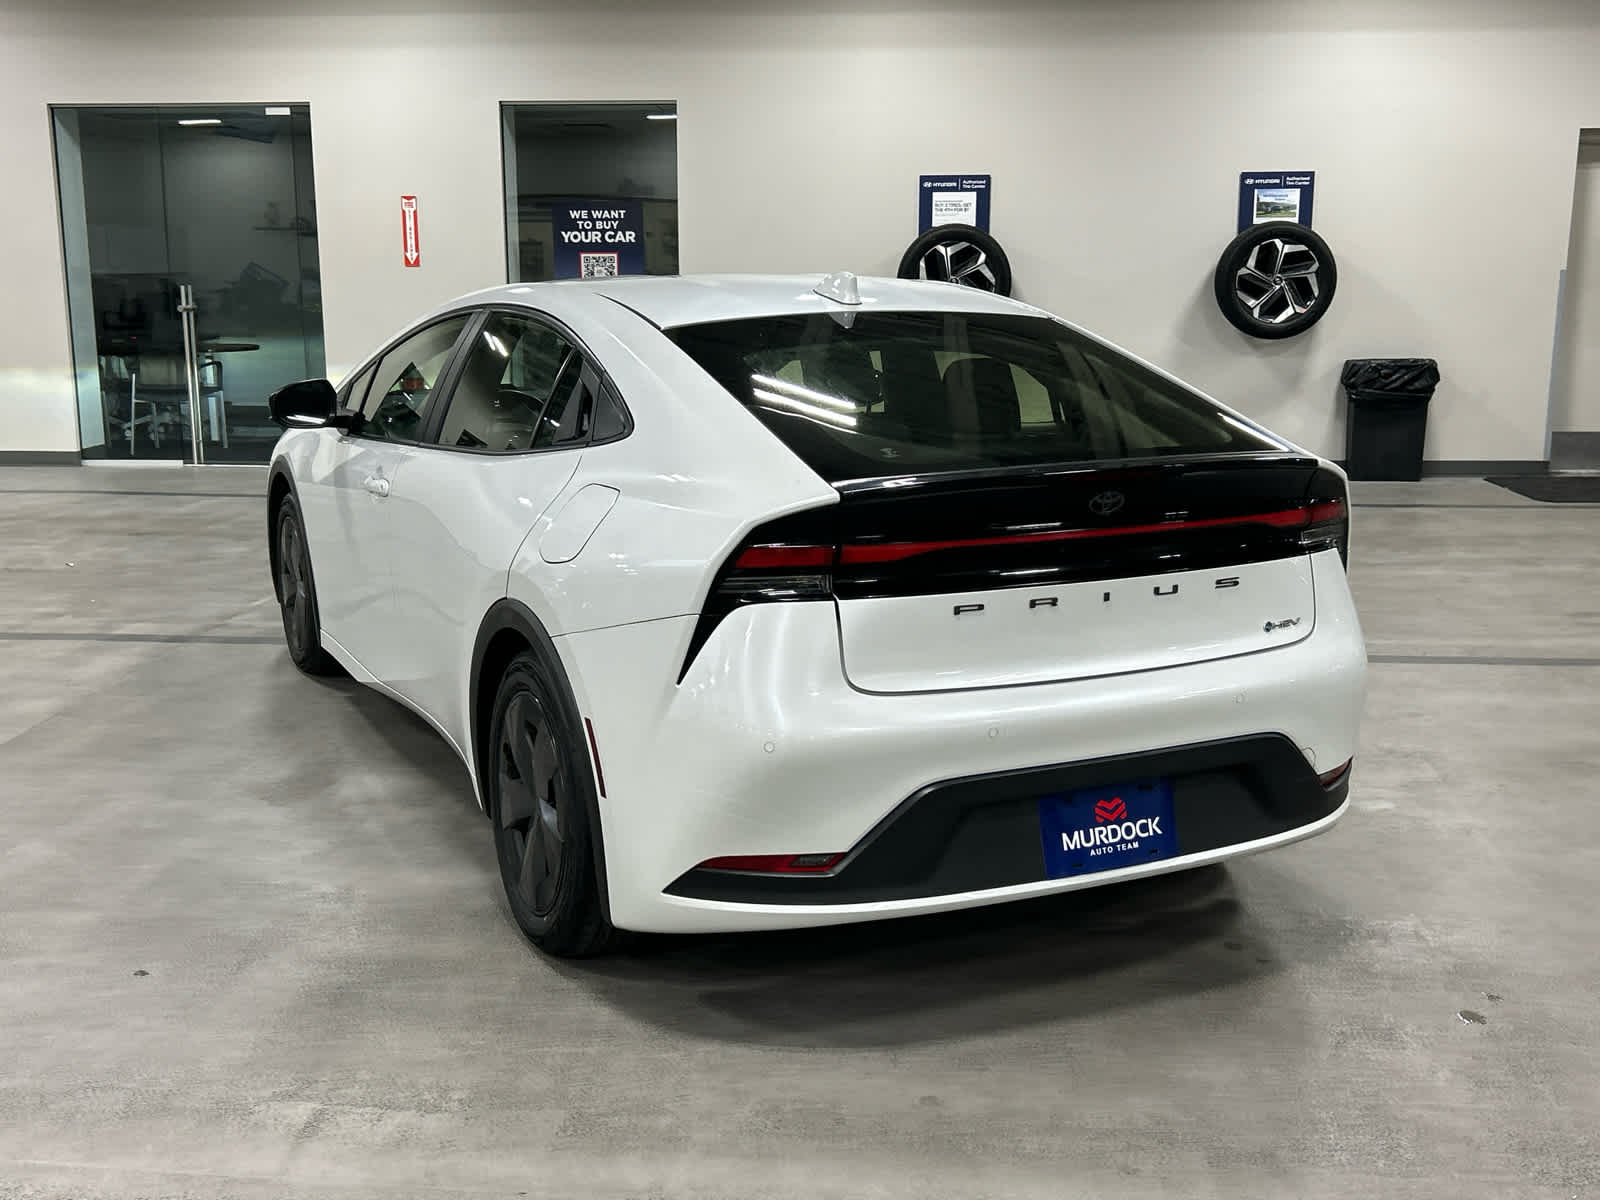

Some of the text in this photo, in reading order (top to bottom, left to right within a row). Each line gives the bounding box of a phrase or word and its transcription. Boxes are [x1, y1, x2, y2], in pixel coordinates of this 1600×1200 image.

[569, 210, 626, 219] WE WANT
[576, 221, 619, 229] TO BUY
[561, 231, 636, 243] YOUR CAR
[953, 577, 1240, 616] PRIUS
[1271, 617, 1301, 630] HEV
[1061, 816, 1163, 851] MURDOCK
[1090, 841, 1139, 856] AUTO TEAM
